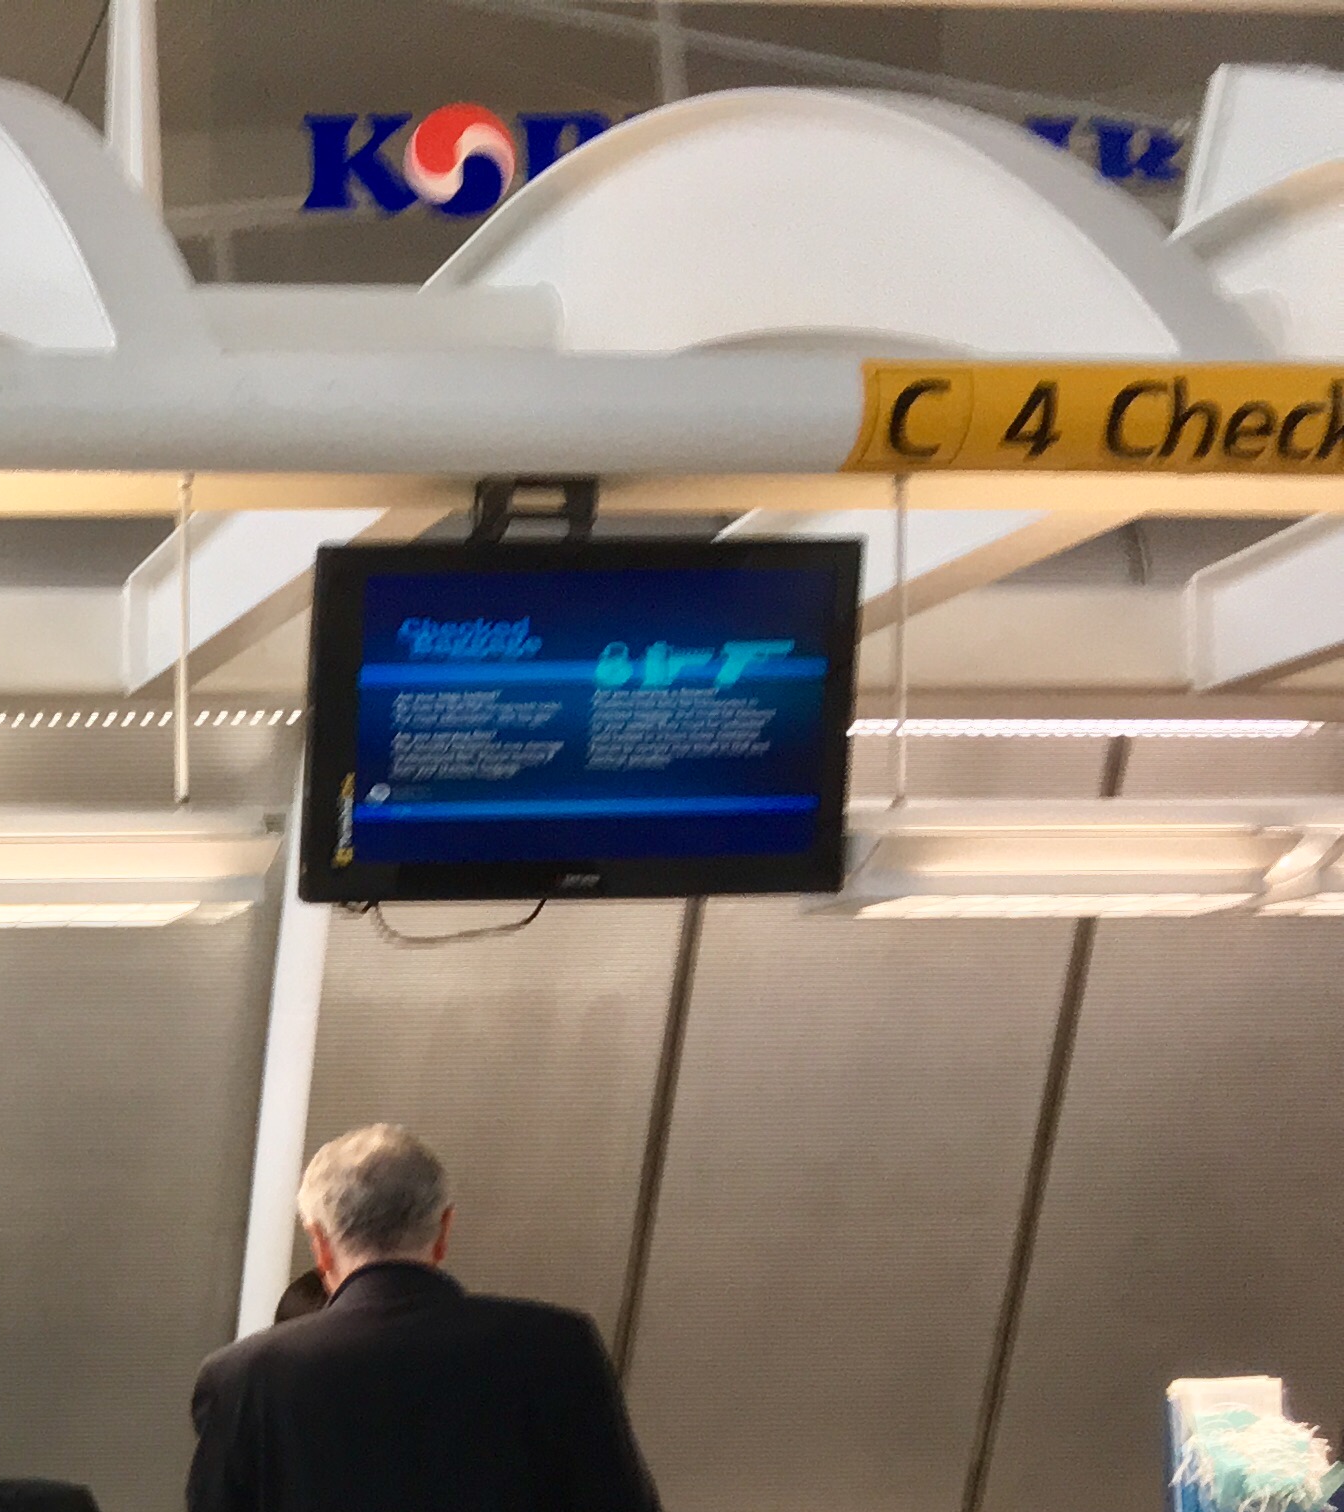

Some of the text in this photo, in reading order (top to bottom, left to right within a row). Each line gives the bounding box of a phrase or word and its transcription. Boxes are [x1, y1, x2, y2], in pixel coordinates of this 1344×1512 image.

[300, 102, 645, 217] KOR
[888, 376, 953, 459] C
[1000, 378, 1062, 461] 4
